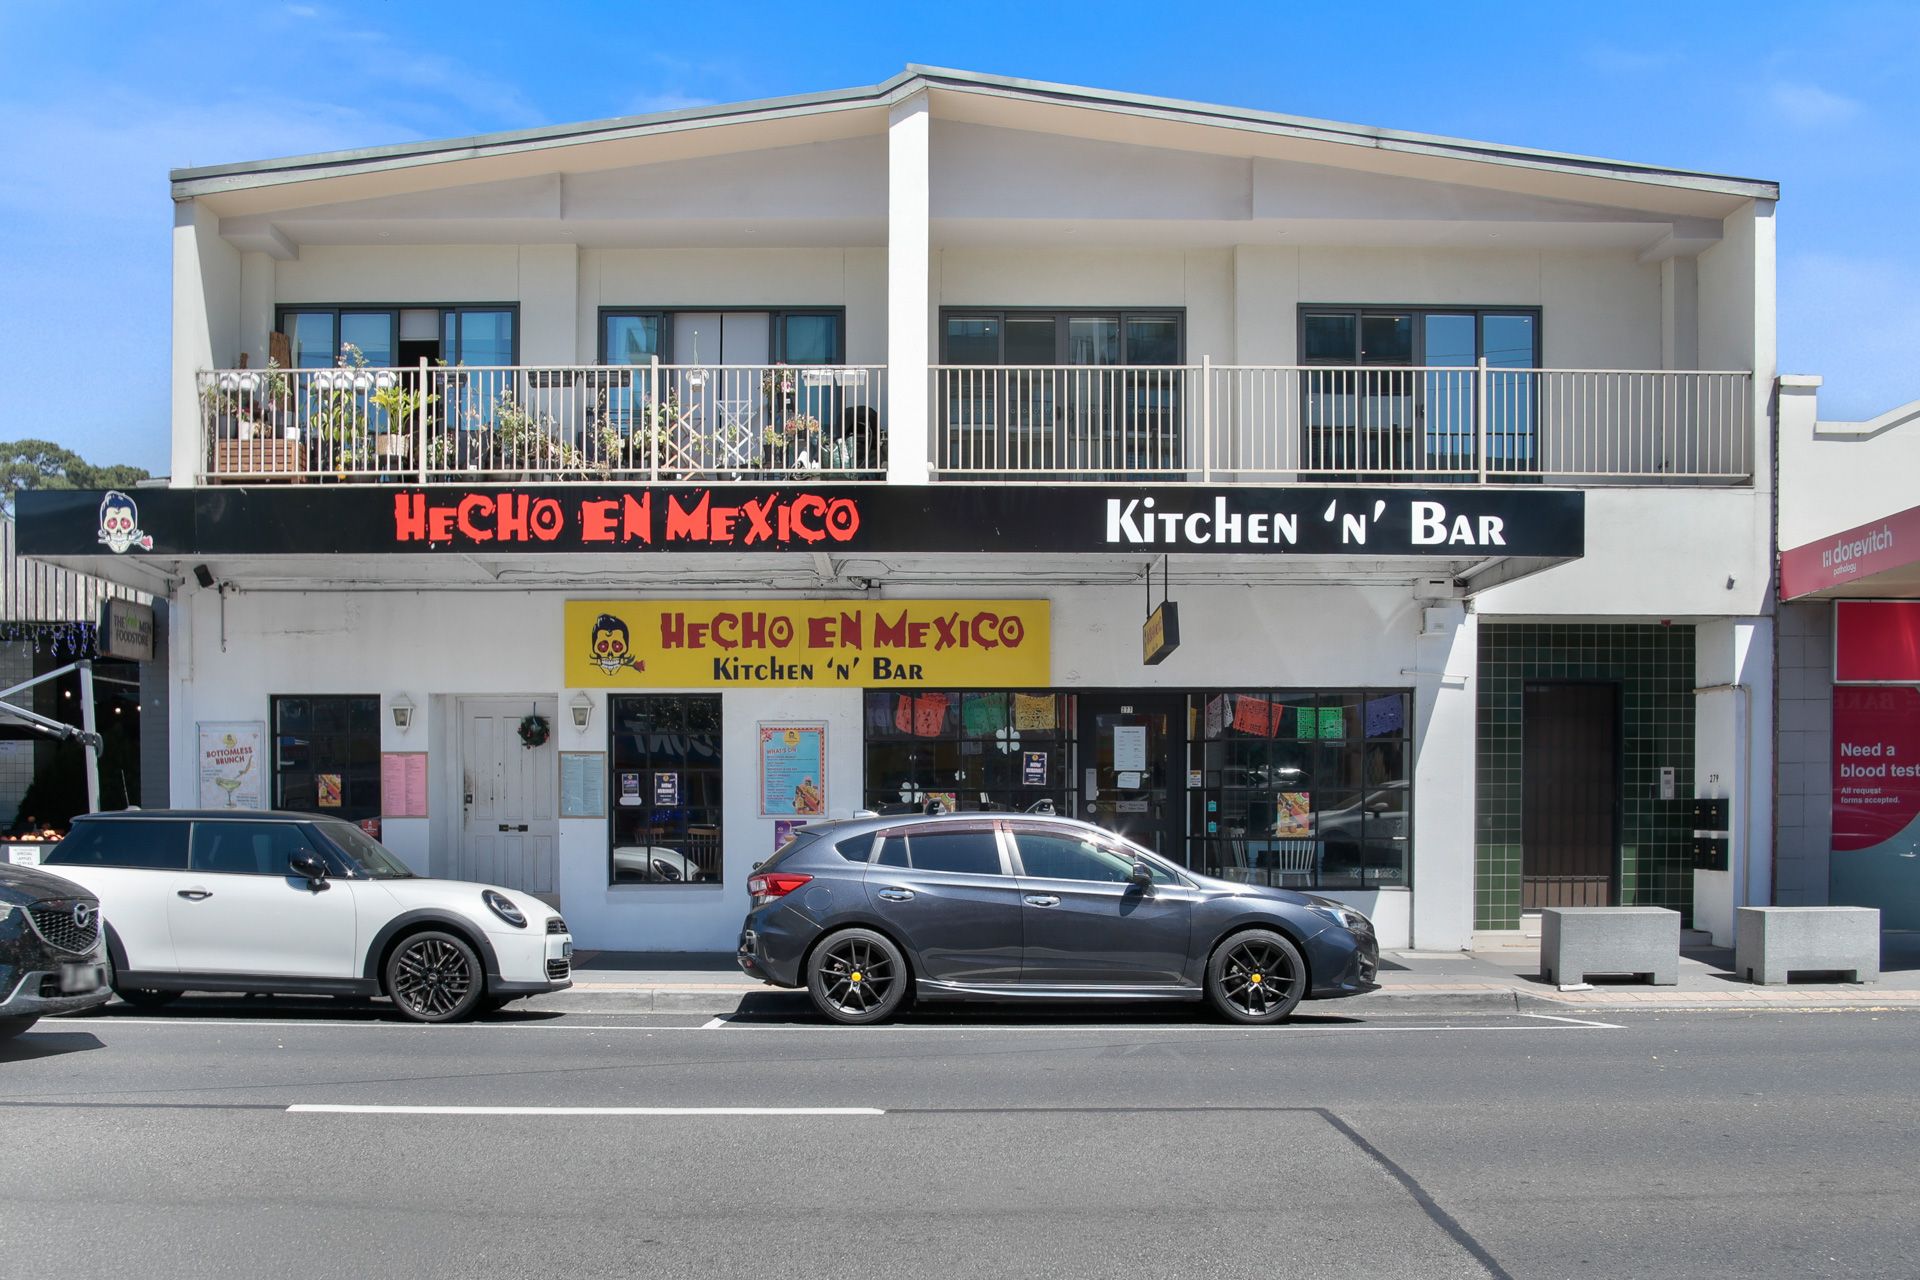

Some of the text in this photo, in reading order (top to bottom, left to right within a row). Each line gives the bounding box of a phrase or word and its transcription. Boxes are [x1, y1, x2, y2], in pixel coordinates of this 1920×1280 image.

[395, 490, 860, 545] HECHO EN MEXICO
[1833, 524, 1893, 564] dorevitch
[1833, 562, 1857, 576] pathology
[660, 609, 1025, 651] HECHO EN MEXICO
[116, 630, 149, 646] FOODSTORE
[206, 746, 253, 758] BOTTOMLESS
[1840, 742, 1896, 756] Need a
[215, 755, 245, 765] BRUNCH
[1840, 763, 1920, 777] blood test
[1709, 774, 1719, 783] 279
[1840, 787, 1882, 796] All request
[1840, 796, 1900, 805] forms accepted.
